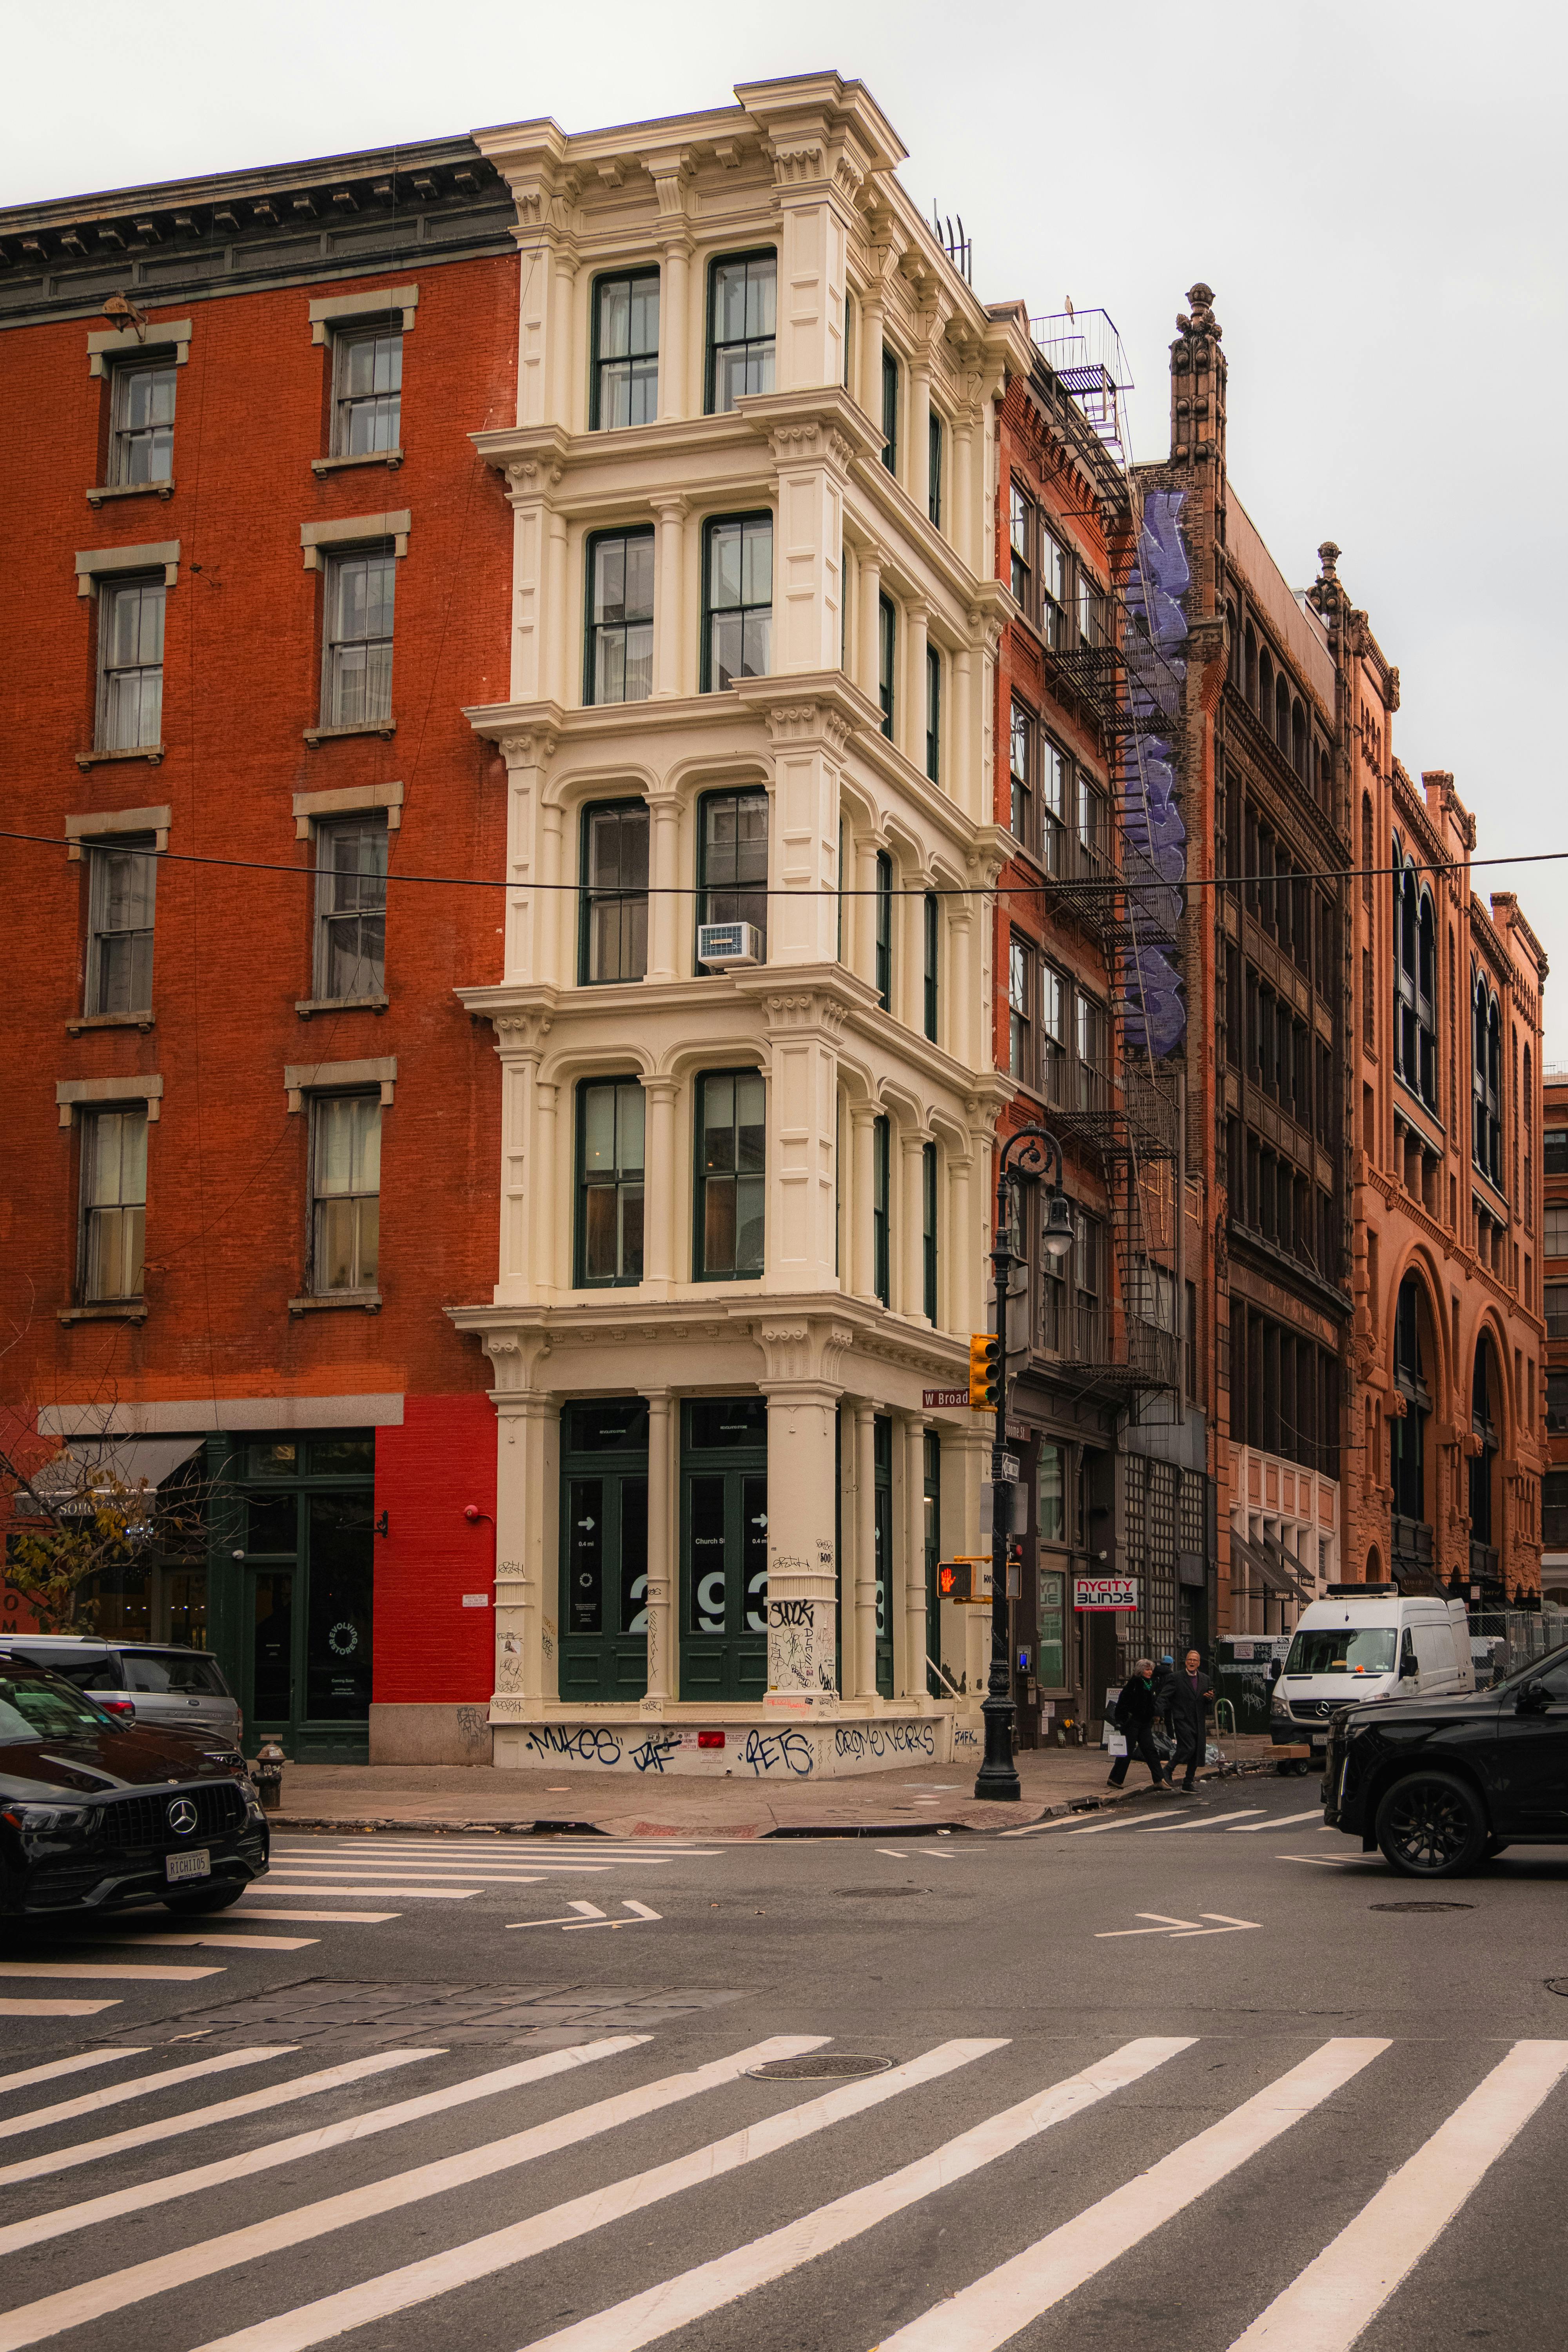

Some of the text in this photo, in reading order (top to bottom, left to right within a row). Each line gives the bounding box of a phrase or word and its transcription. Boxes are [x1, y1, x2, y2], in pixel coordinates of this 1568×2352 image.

[925, 1391, 968, 1405] W Broad
[1006, 1425, 1025, 1438] roome St
[1077, 1581, 1133, 1592] NYCITY
[1077, 1593, 1134, 1604] BLINDS
